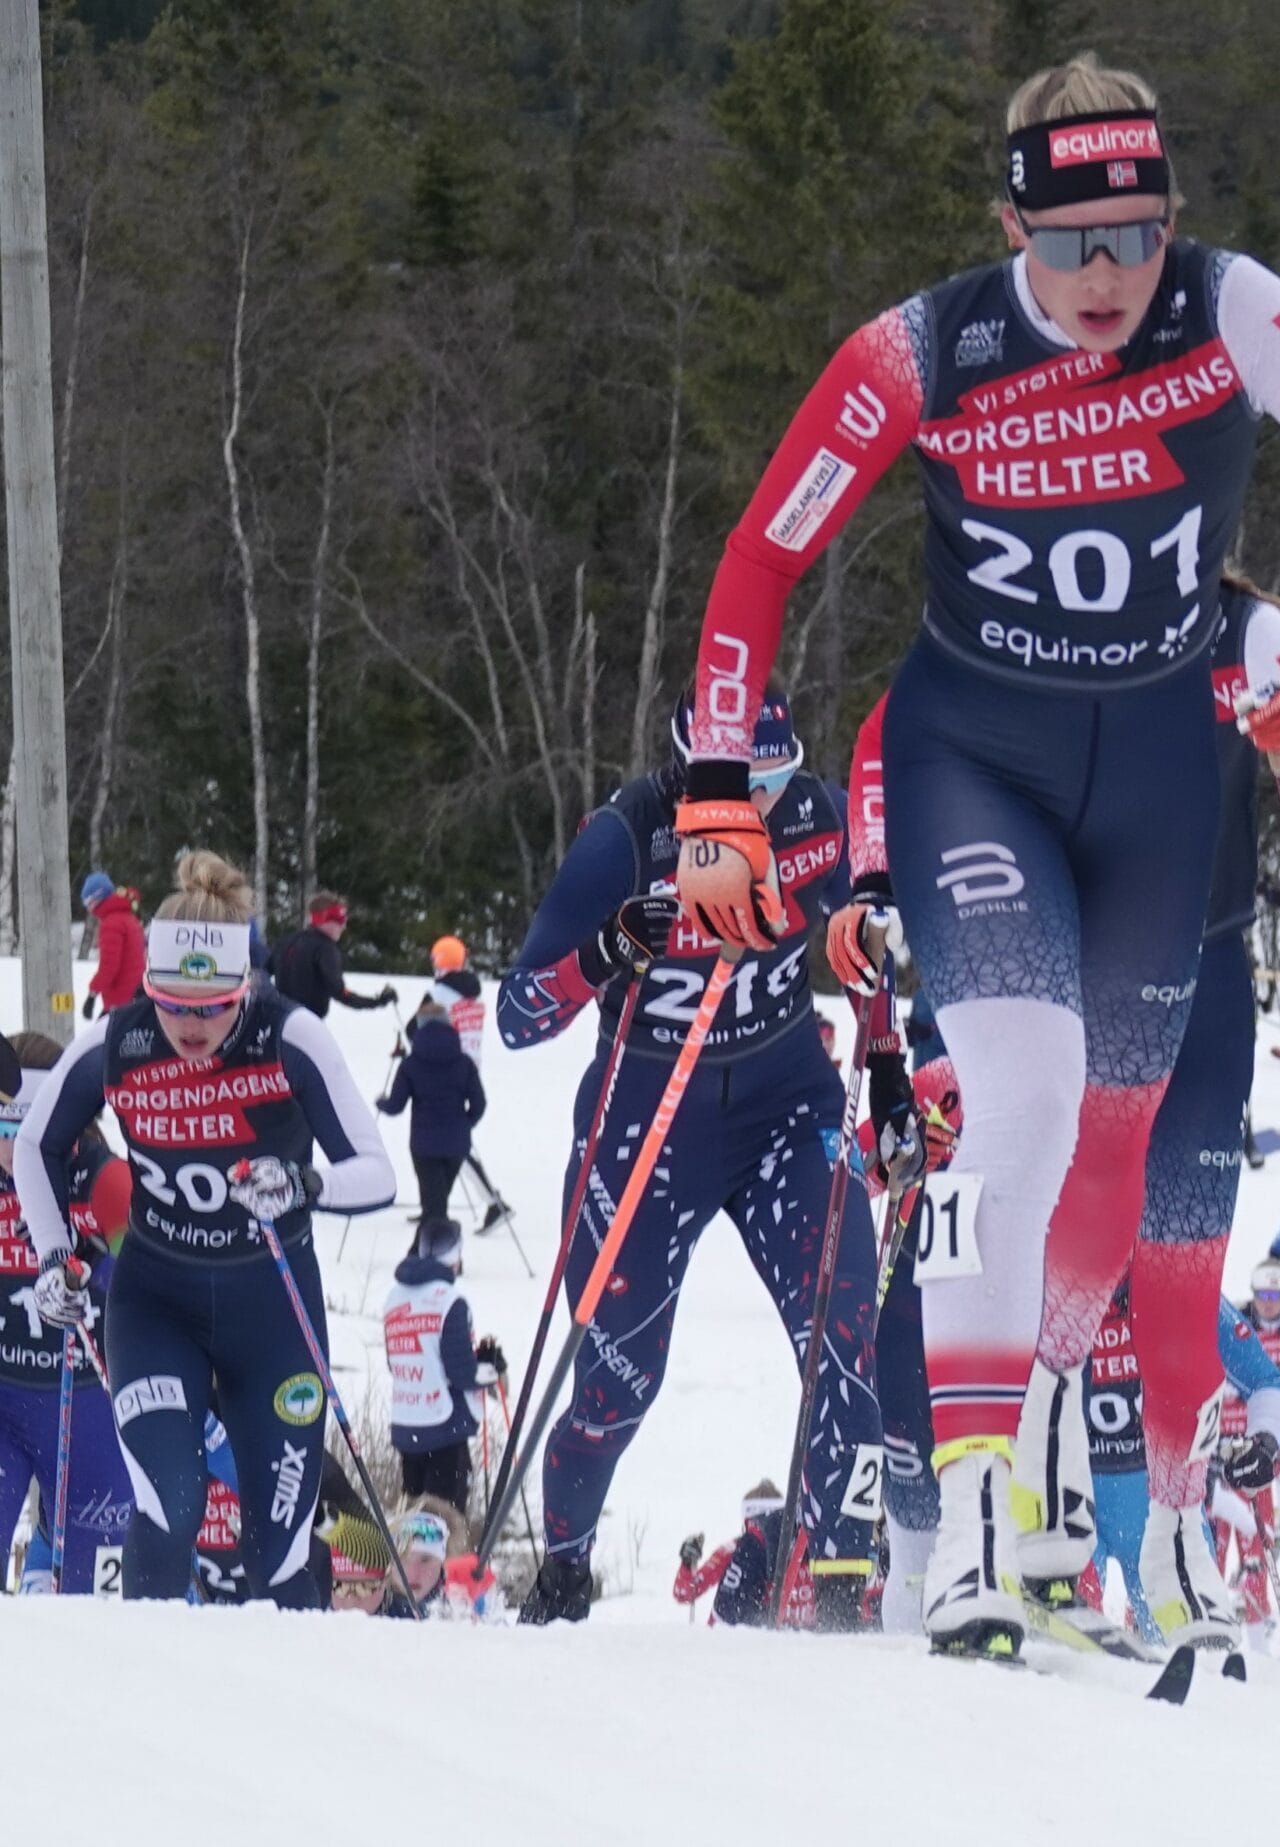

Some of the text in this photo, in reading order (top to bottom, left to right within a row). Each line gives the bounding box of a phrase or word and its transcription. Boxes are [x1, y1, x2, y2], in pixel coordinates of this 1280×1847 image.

[1053, 125, 1146, 160] equinor
[918, 356, 1235, 455] MORGENDAGENS
[973, 353, 1105, 414] VI STØTTER
[976, 450, 1152, 498] HELTER
[961, 504, 1203, 613] 201
[980, 620, 1149, 667] equinor
[174, 922, 224, 952] DNB
[132, 1072, 148, 1086] VI
[135, 1113, 236, 1142] HELTER
[130, 1148, 228, 1214] 20
[118, 1378, 178, 1417] DNB
